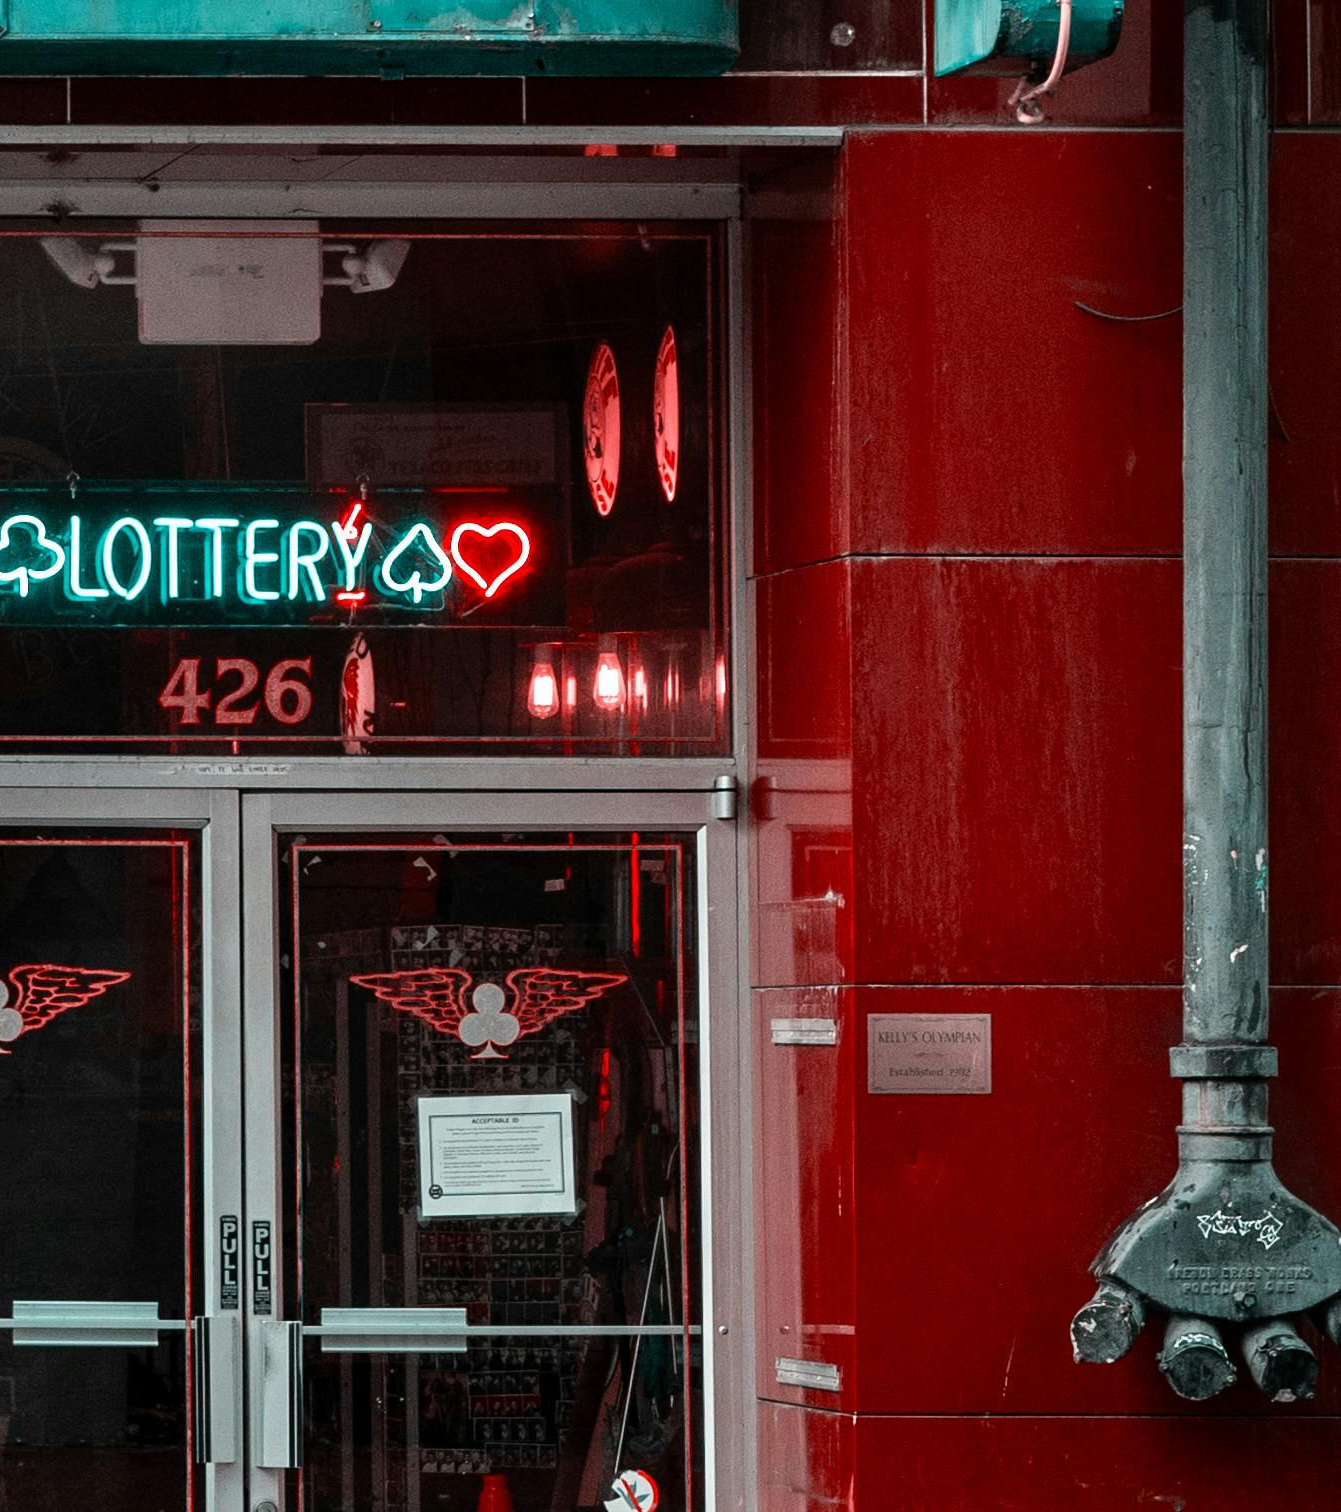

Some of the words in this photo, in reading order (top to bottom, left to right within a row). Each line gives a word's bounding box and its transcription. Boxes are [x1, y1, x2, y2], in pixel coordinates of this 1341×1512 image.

[70, 515, 373, 602] LOTTERY
[157, 656, 314, 725] 426
[222, 1222, 236, 1285] PULL
[255, 1228, 269, 1291] PULL
